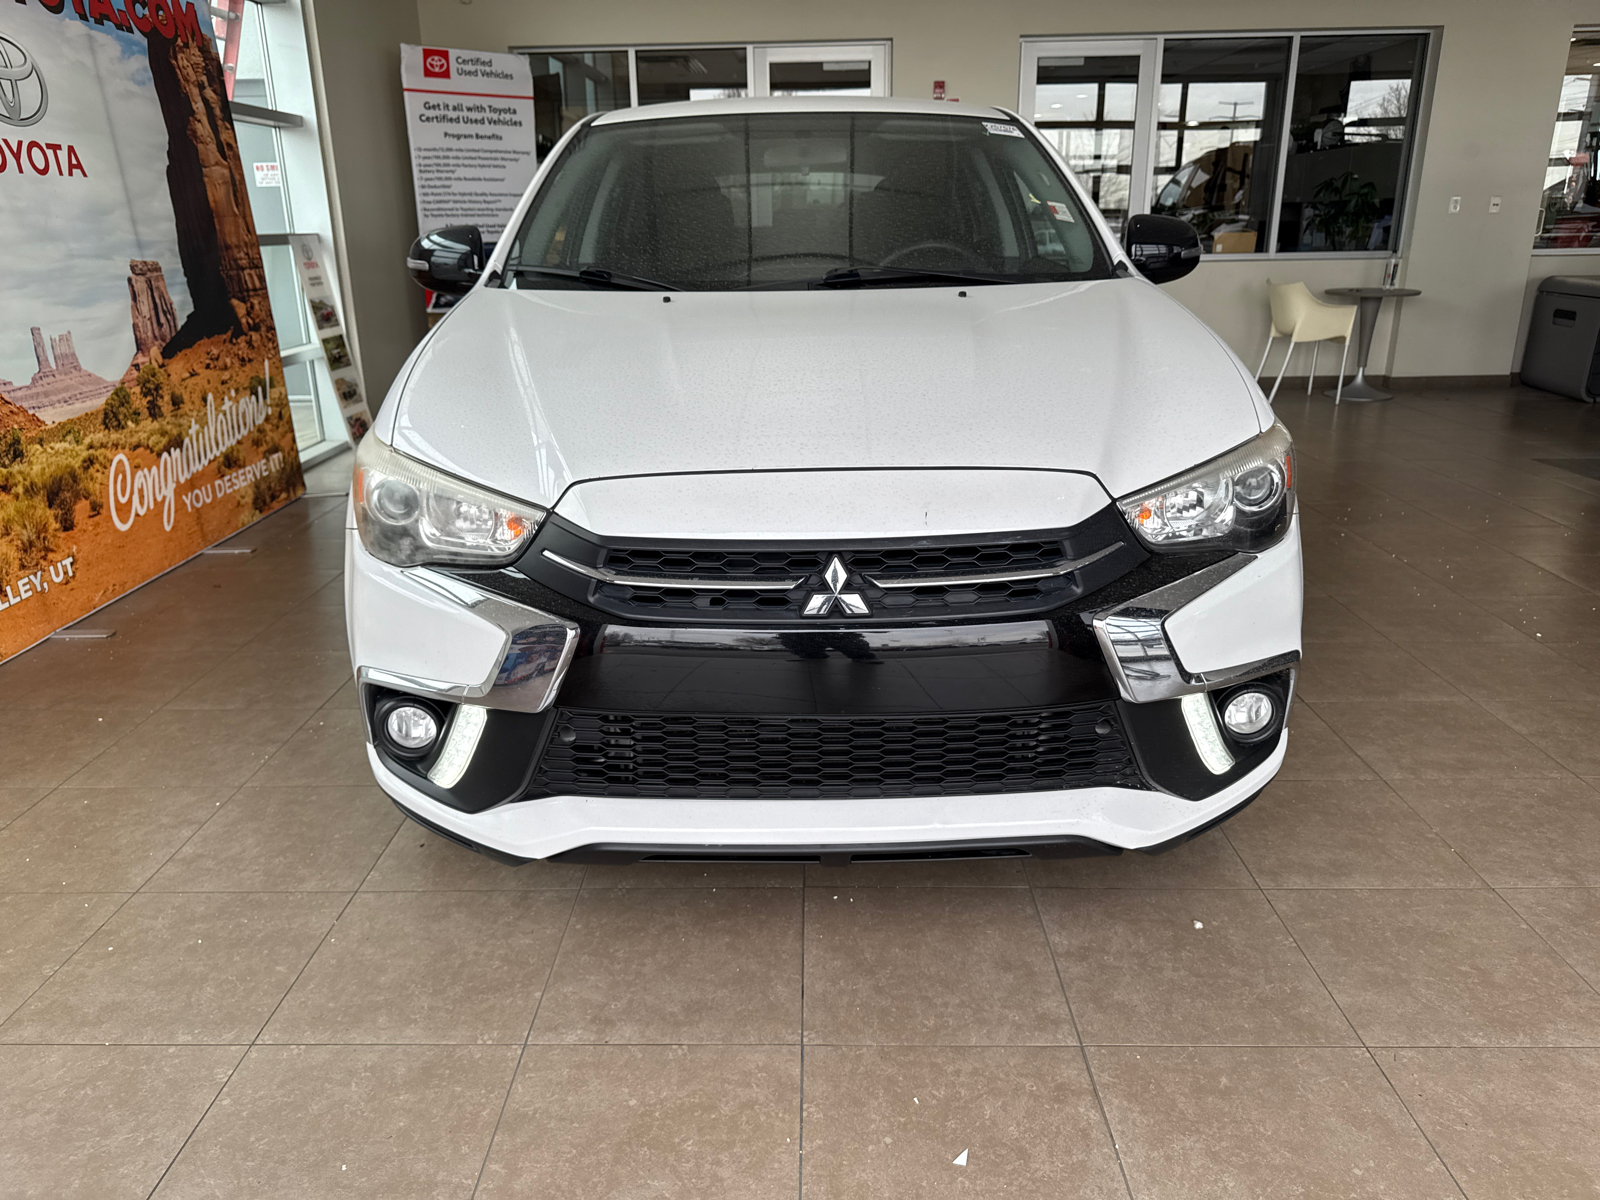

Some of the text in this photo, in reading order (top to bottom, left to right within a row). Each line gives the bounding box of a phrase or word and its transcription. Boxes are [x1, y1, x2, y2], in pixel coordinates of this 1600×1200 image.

[455, 55, 493, 68] Certified
[456, 67, 514, 80] Used Vehicles
[423, 101, 517, 116] Get it all with Toyota
[419, 113, 523, 128] Certified Used Vehicles
[443, 131, 503, 141] Program Benefits
[108, 359, 273, 532] Congratulations!
[182, 452, 284, 513] YOU DESERVE IT!
[49, 556, 74, 584] UT
